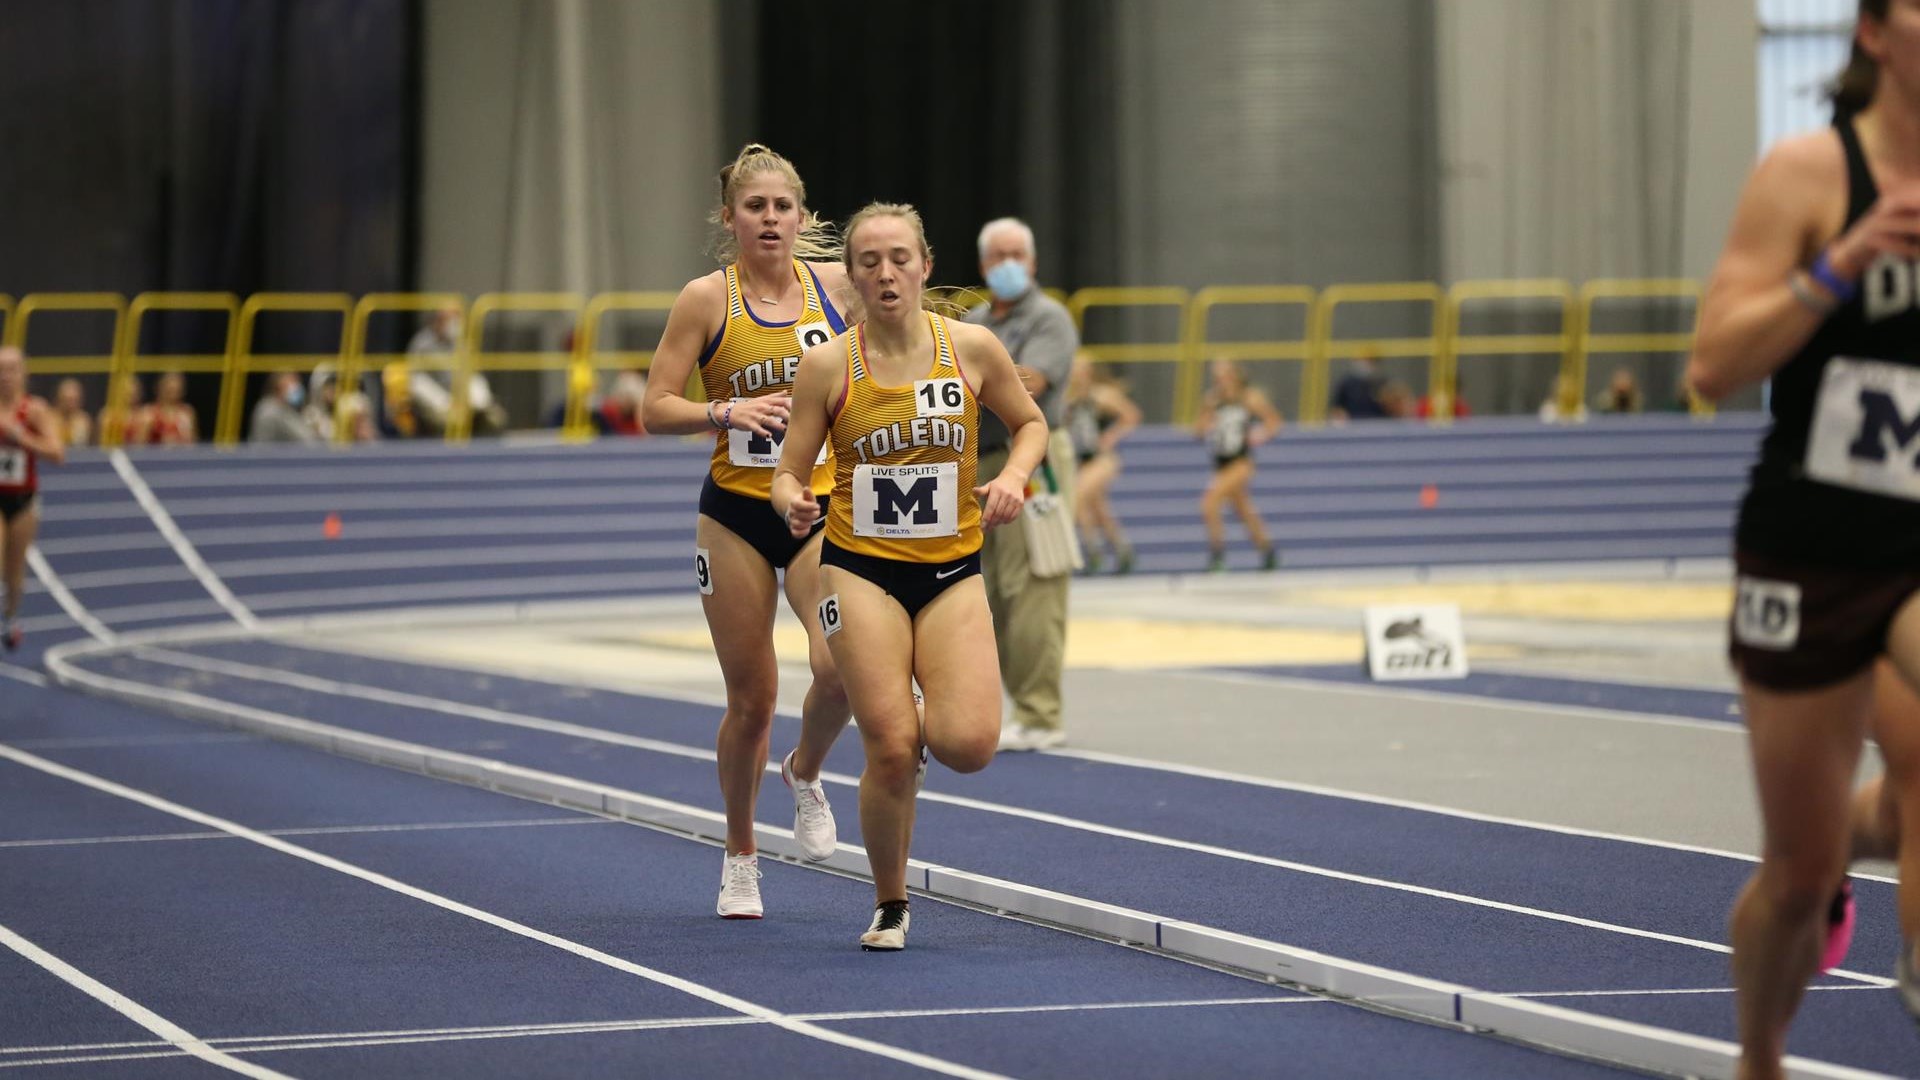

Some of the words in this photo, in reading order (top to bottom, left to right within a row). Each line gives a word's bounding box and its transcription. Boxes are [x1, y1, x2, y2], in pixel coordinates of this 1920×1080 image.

[728, 355, 800, 398] TOLE
[920, 382, 961, 408] 16
[853, 417, 966, 463] TOLEDO
[871, 467, 896, 476] LIVE
[899, 466, 939, 476] SPLITS
[873, 477, 938, 525] M
[697, 555, 709, 587] 9
[819, 600, 838, 631] 16
